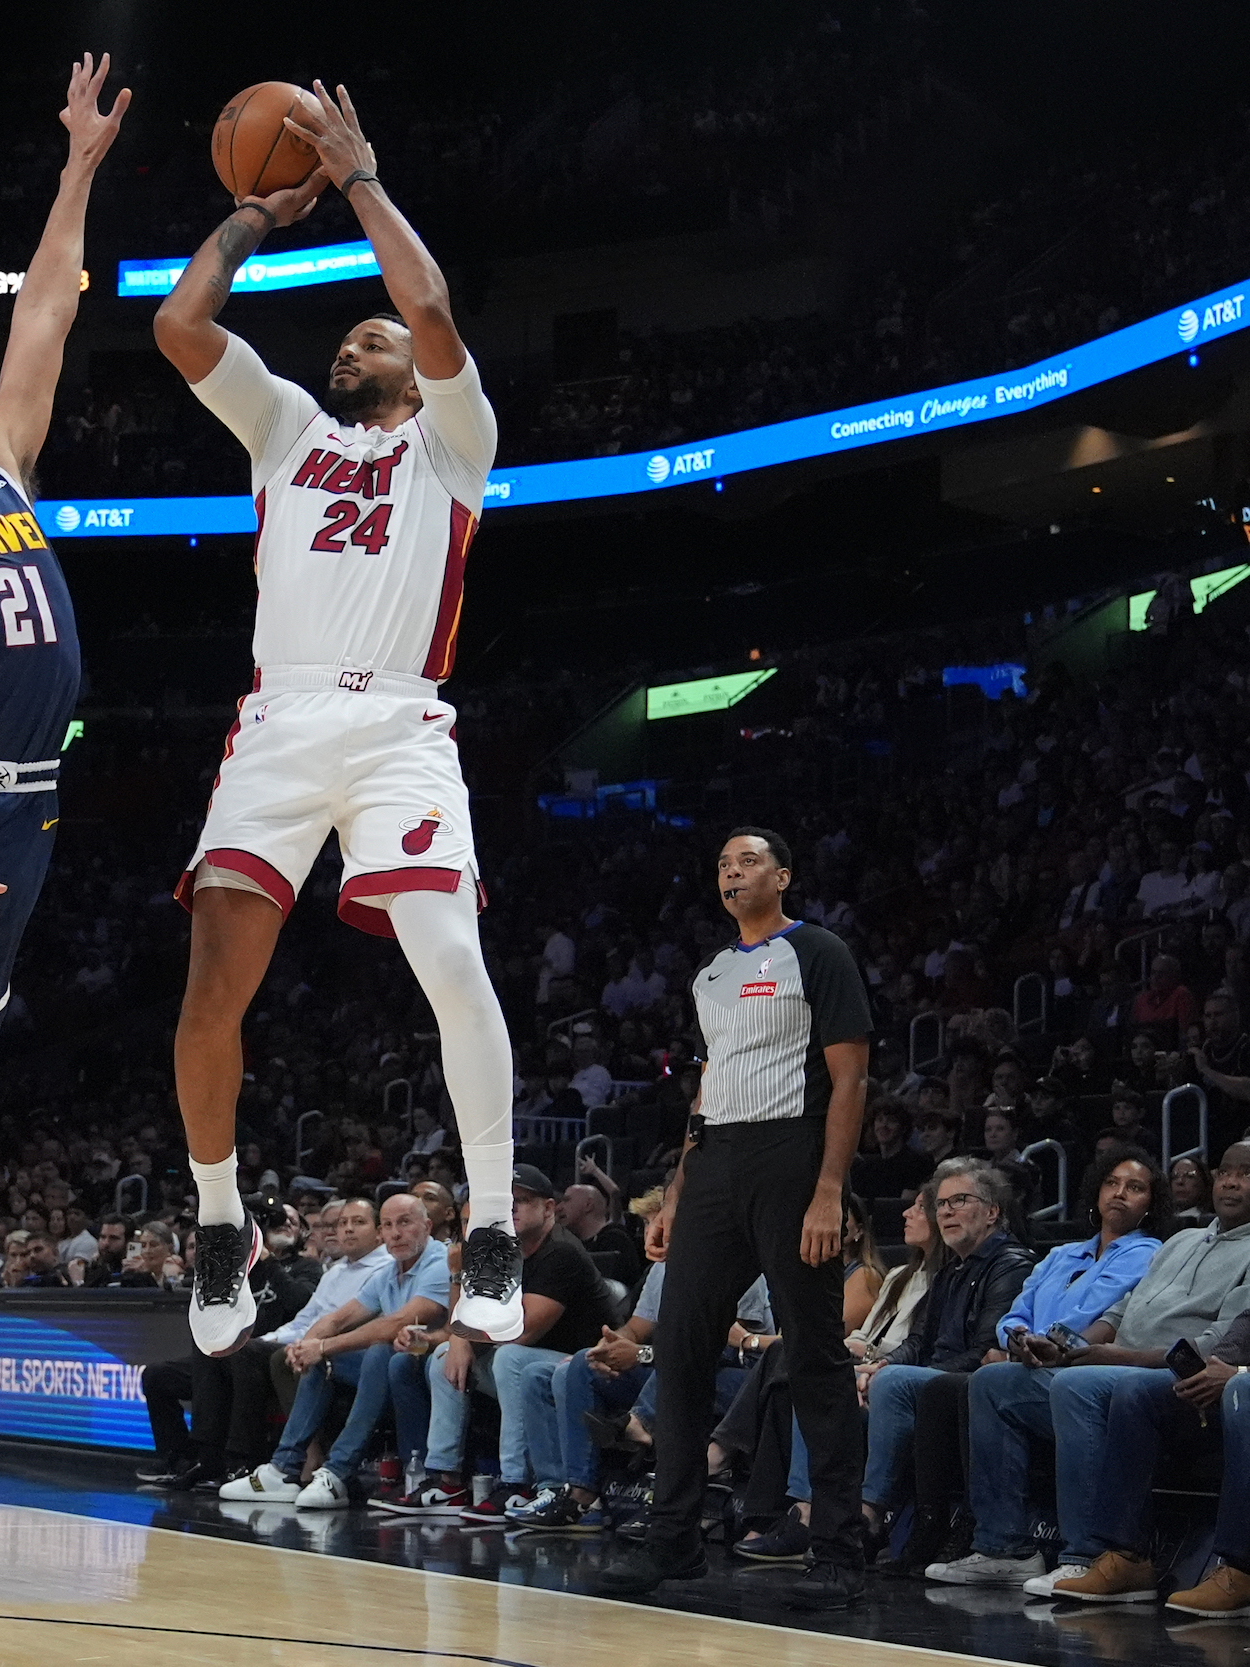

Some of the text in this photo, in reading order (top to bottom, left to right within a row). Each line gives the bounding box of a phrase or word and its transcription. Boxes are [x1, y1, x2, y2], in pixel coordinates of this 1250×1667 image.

[673, 294, 1246, 476] AT&T Connecting Changes Everything AT&T
[290, 440, 409, 500] HEAT
[84, 508, 134, 528] AT&T
[309, 499, 394, 556] 24
[741, 985, 775, 996] Emirates
[21, 1359, 85, 1398] SPORTS
